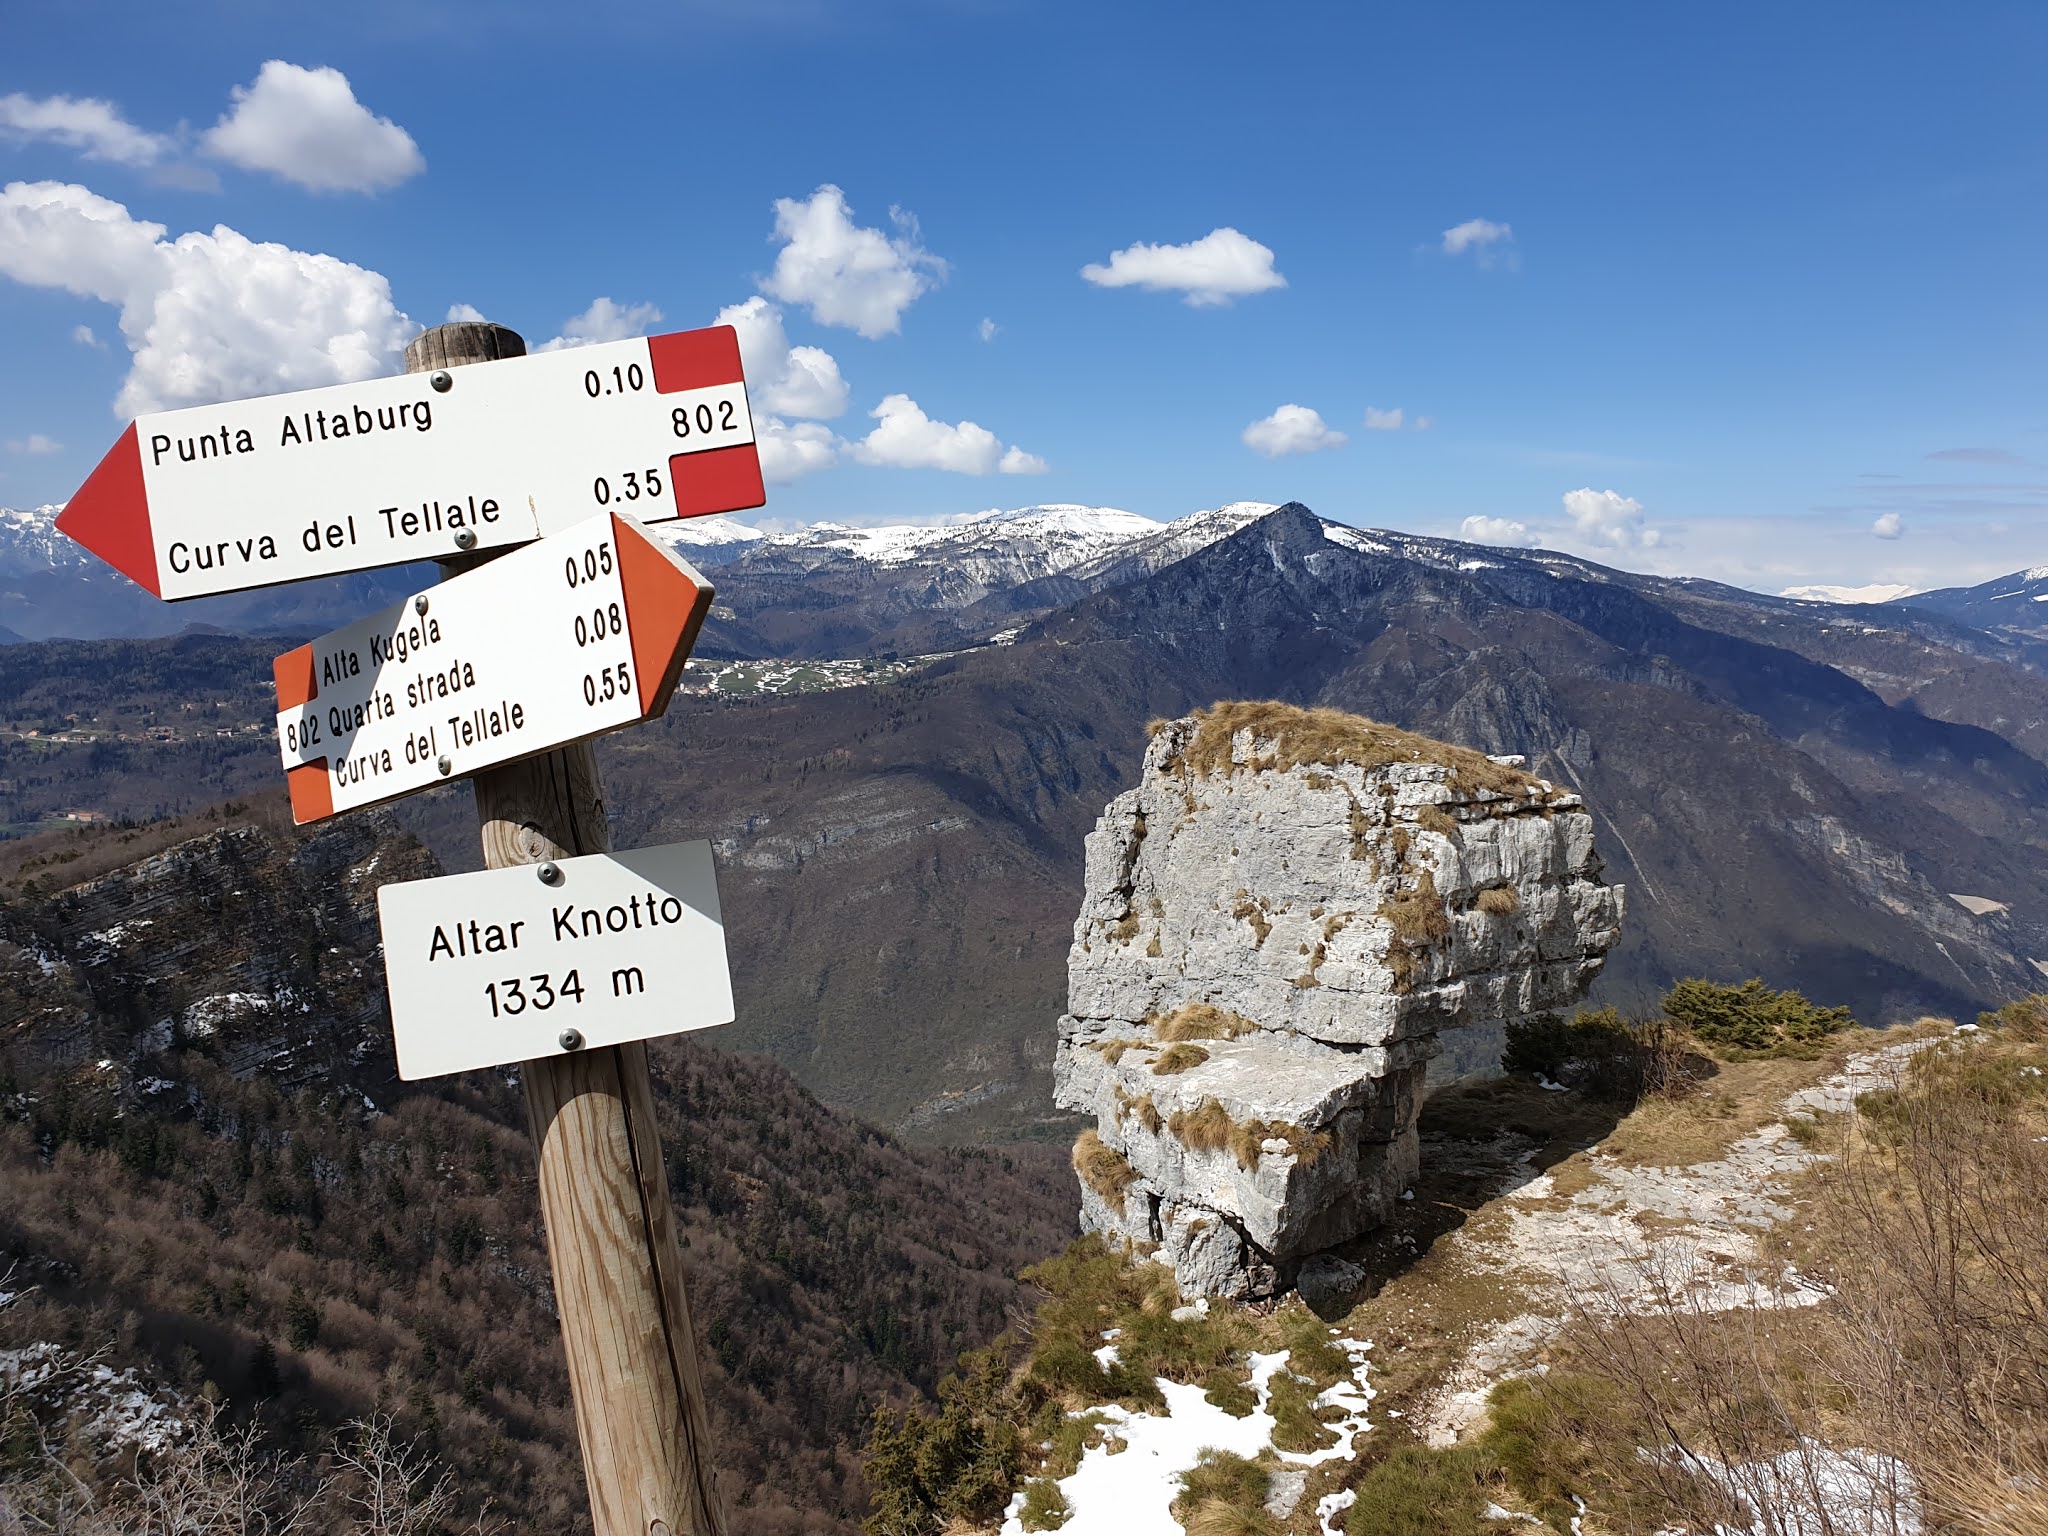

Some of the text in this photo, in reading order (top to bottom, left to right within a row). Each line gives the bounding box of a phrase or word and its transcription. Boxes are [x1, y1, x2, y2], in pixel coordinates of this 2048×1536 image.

[151, 363, 645, 466] Punta Altaburg 0.10
[670, 400, 739, 438] 802
[168, 467, 663, 575] Curva del Tellale 0.35
[323, 542, 613, 688] Alta Kugela 0.05
[328, 603, 622, 737] Quarta strada 0.08
[287, 713, 322, 753] 802
[335, 662, 631, 788] Curva del Tellale 0.55
[429, 892, 682, 962] Altar Knotto
[484, 966, 645, 1018] 1334 m
